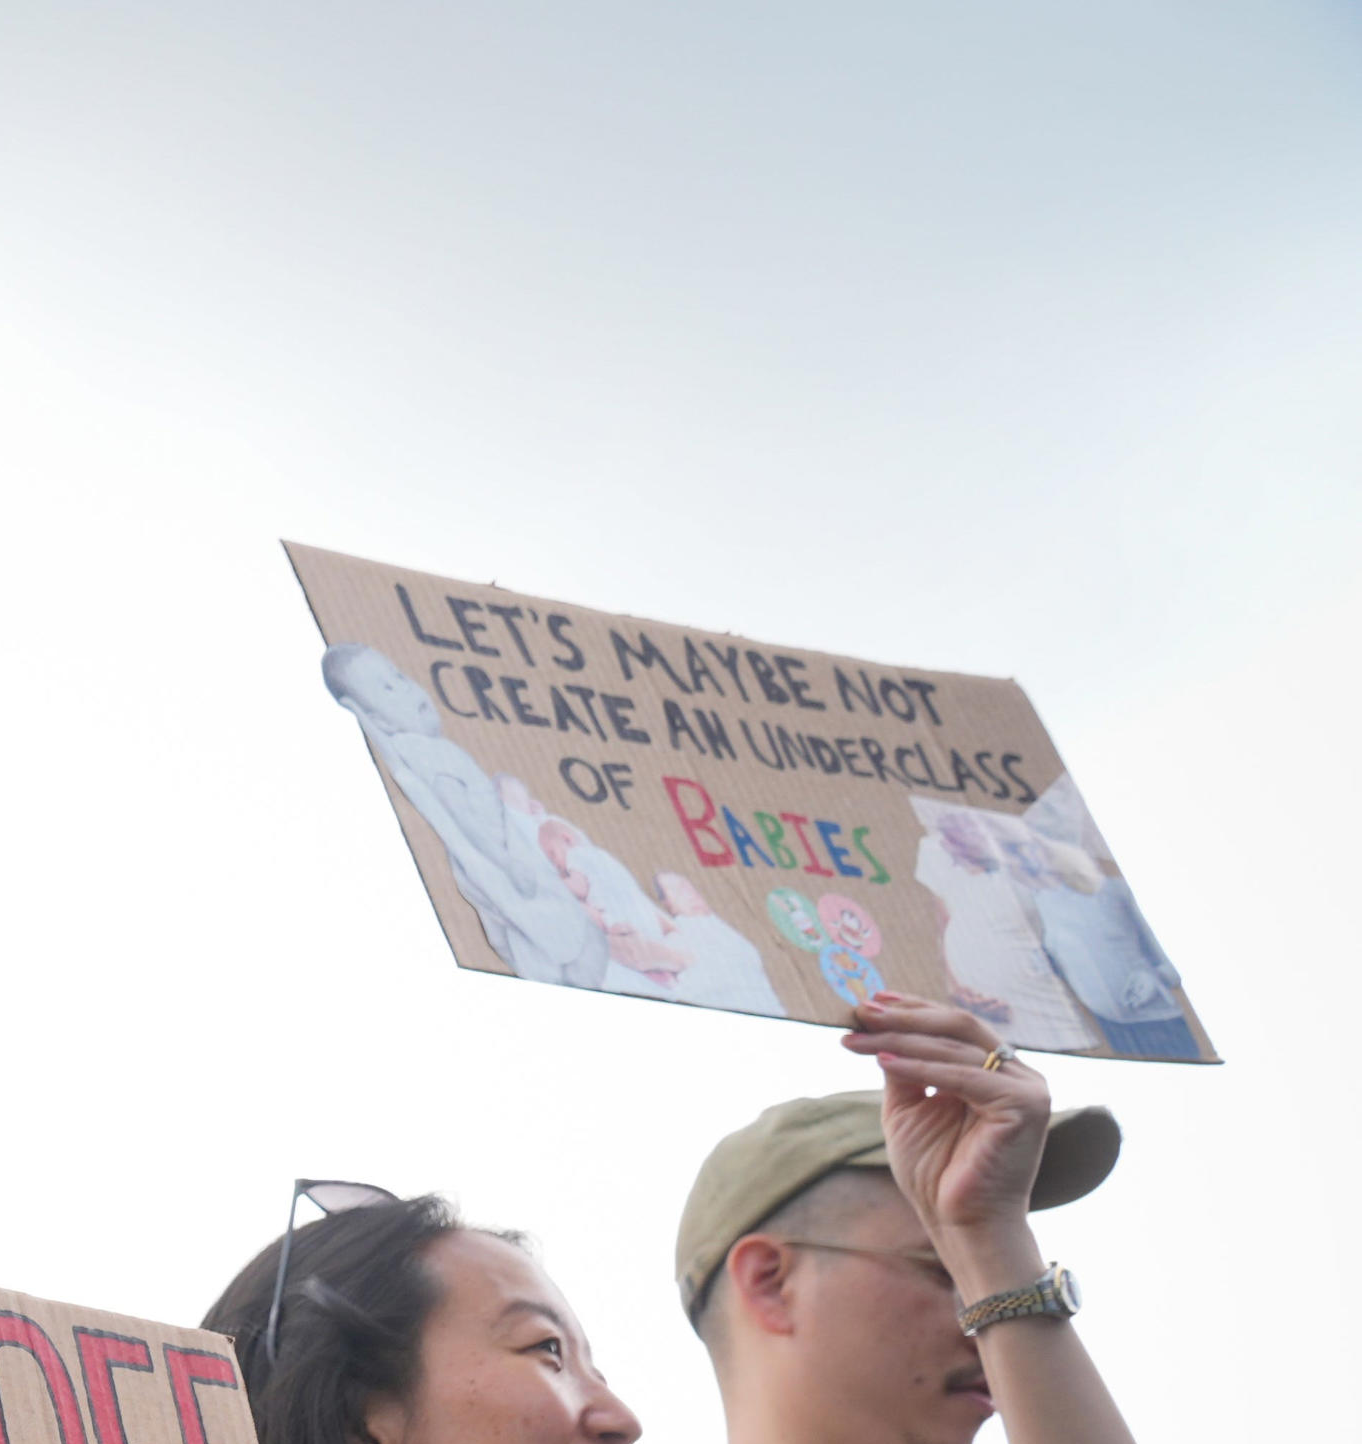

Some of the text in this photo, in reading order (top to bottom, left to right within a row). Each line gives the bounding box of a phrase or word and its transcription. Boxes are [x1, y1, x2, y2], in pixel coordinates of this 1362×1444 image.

[395, 583, 943, 727] LET'S MAYBE NOT
[430, 661, 1038, 804] CREATE AN UNDERCLASS
[559, 756, 891, 884] OF BABIES
